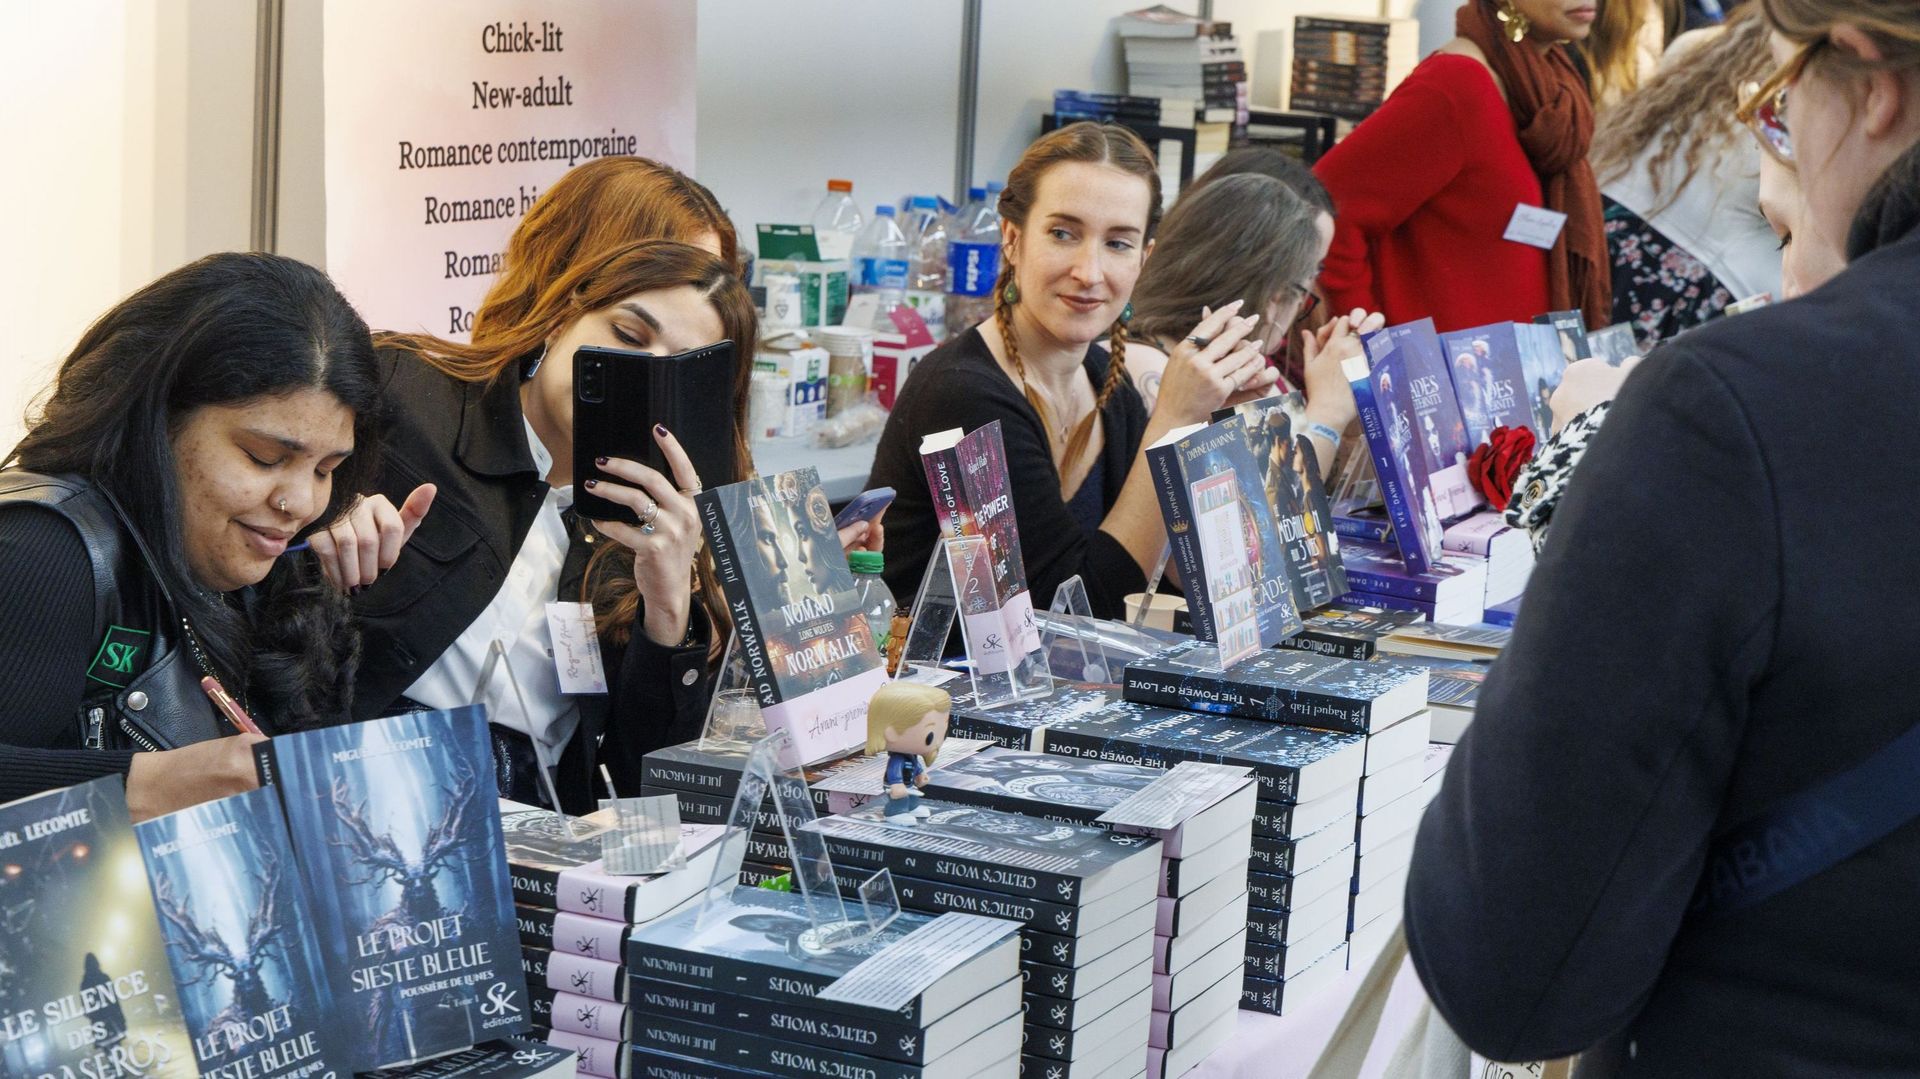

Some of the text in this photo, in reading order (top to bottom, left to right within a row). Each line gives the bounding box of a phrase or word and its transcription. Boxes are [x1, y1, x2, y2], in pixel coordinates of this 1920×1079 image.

[482, 22, 564, 53] Chick-lit
[472, 76, 573, 109] New-adult
[399, 128, 637, 169] Romance contemporaine
[424, 195, 515, 225] Romance
[445, 250, 508, 279] Roma
[1410, 375, 1440, 398] ADES
[937, 461, 951, 494] LOVE
[945, 493, 955, 510] OF
[983, 494, 1009, 524] POWER
[704, 501, 728, 556] HAROUN
[949, 509, 967, 550] POWER
[721, 556, 740, 584] JULIE
[968, 577, 980, 594] 2
[1253, 575, 1288, 606] CADE
[781, 593, 835, 628] NOMAD
[1190, 576, 1214, 641] BERYL MONCADE
[733, 599, 768, 679] NORWALK
[798, 622, 835, 642] LONE WOLVES
[102, 642, 139, 673] SK
[785, 633, 862, 677] NORWALK
[1129, 679, 1245, 705] THE POWER OF LOVE
[1290, 702, 1348, 720] Raquel Hab
[1351, 709, 1361, 726] SK
[951, 729, 973, 741] Hab
[1050, 743, 1168, 770] THE POWER OF LOVE
[260, 752, 275, 786] COMTE
[650, 767, 723, 789] JULIE HAROUN
[695, 804, 722, 818] JULIE
[24, 808, 92, 841] LECOMTE
[860, 849, 1037, 889] CELTIC'S WOLFS 2 JULIE
[511, 875, 541, 893] WOL
[902, 888, 914, 899] 2
[1057, 879, 1075, 900] SK
[934, 891, 978, 910] WOLFS
[979, 900, 1035, 921] CELTIC'S
[1055, 910, 1072, 932] SK
[356, 914, 464, 958] LE PROJET
[1053, 941, 1070, 962] SK
[351, 957, 420, 992] SIESTE
[422, 942, 493, 976] BLEUE
[642, 954, 688, 975] HAROUN
[689, 965, 713, 979] JULIE
[400, 969, 495, 999] POUSSIÈRE DE LUNES
[769, 977, 817, 997] WOLFS
[1051, 972, 1069, 994] SK
[2, 970, 149, 1041] LE SILENCE
[480, 981, 521, 1016] SK
[644, 991, 688, 1012] HAROUN
[690, 1002, 716, 1016] JULIE
[482, 1013, 523, 1030] éditions
[770, 1013, 819, 1033] WOLFS
[1050, 1004, 1068, 1025] SK
[66, 1021, 109, 1051] DES
[195, 1003, 293, 1061] LE PROJET
[646, 1027, 689, 1047] HAROUN
[819, 1022, 878, 1045] CELTIC'S
[200, 1030, 321, 1079] IESTE BLEUE
[690, 1037, 716, 1052] JULIE
[899, 1033, 917, 1057] SK
[1049, 1034, 1067, 1055] SK
[512, 1048, 552, 1066] SK
[770, 1049, 818, 1070] WOLFS
[819, 1060, 877, 1079] CELTIC'S
